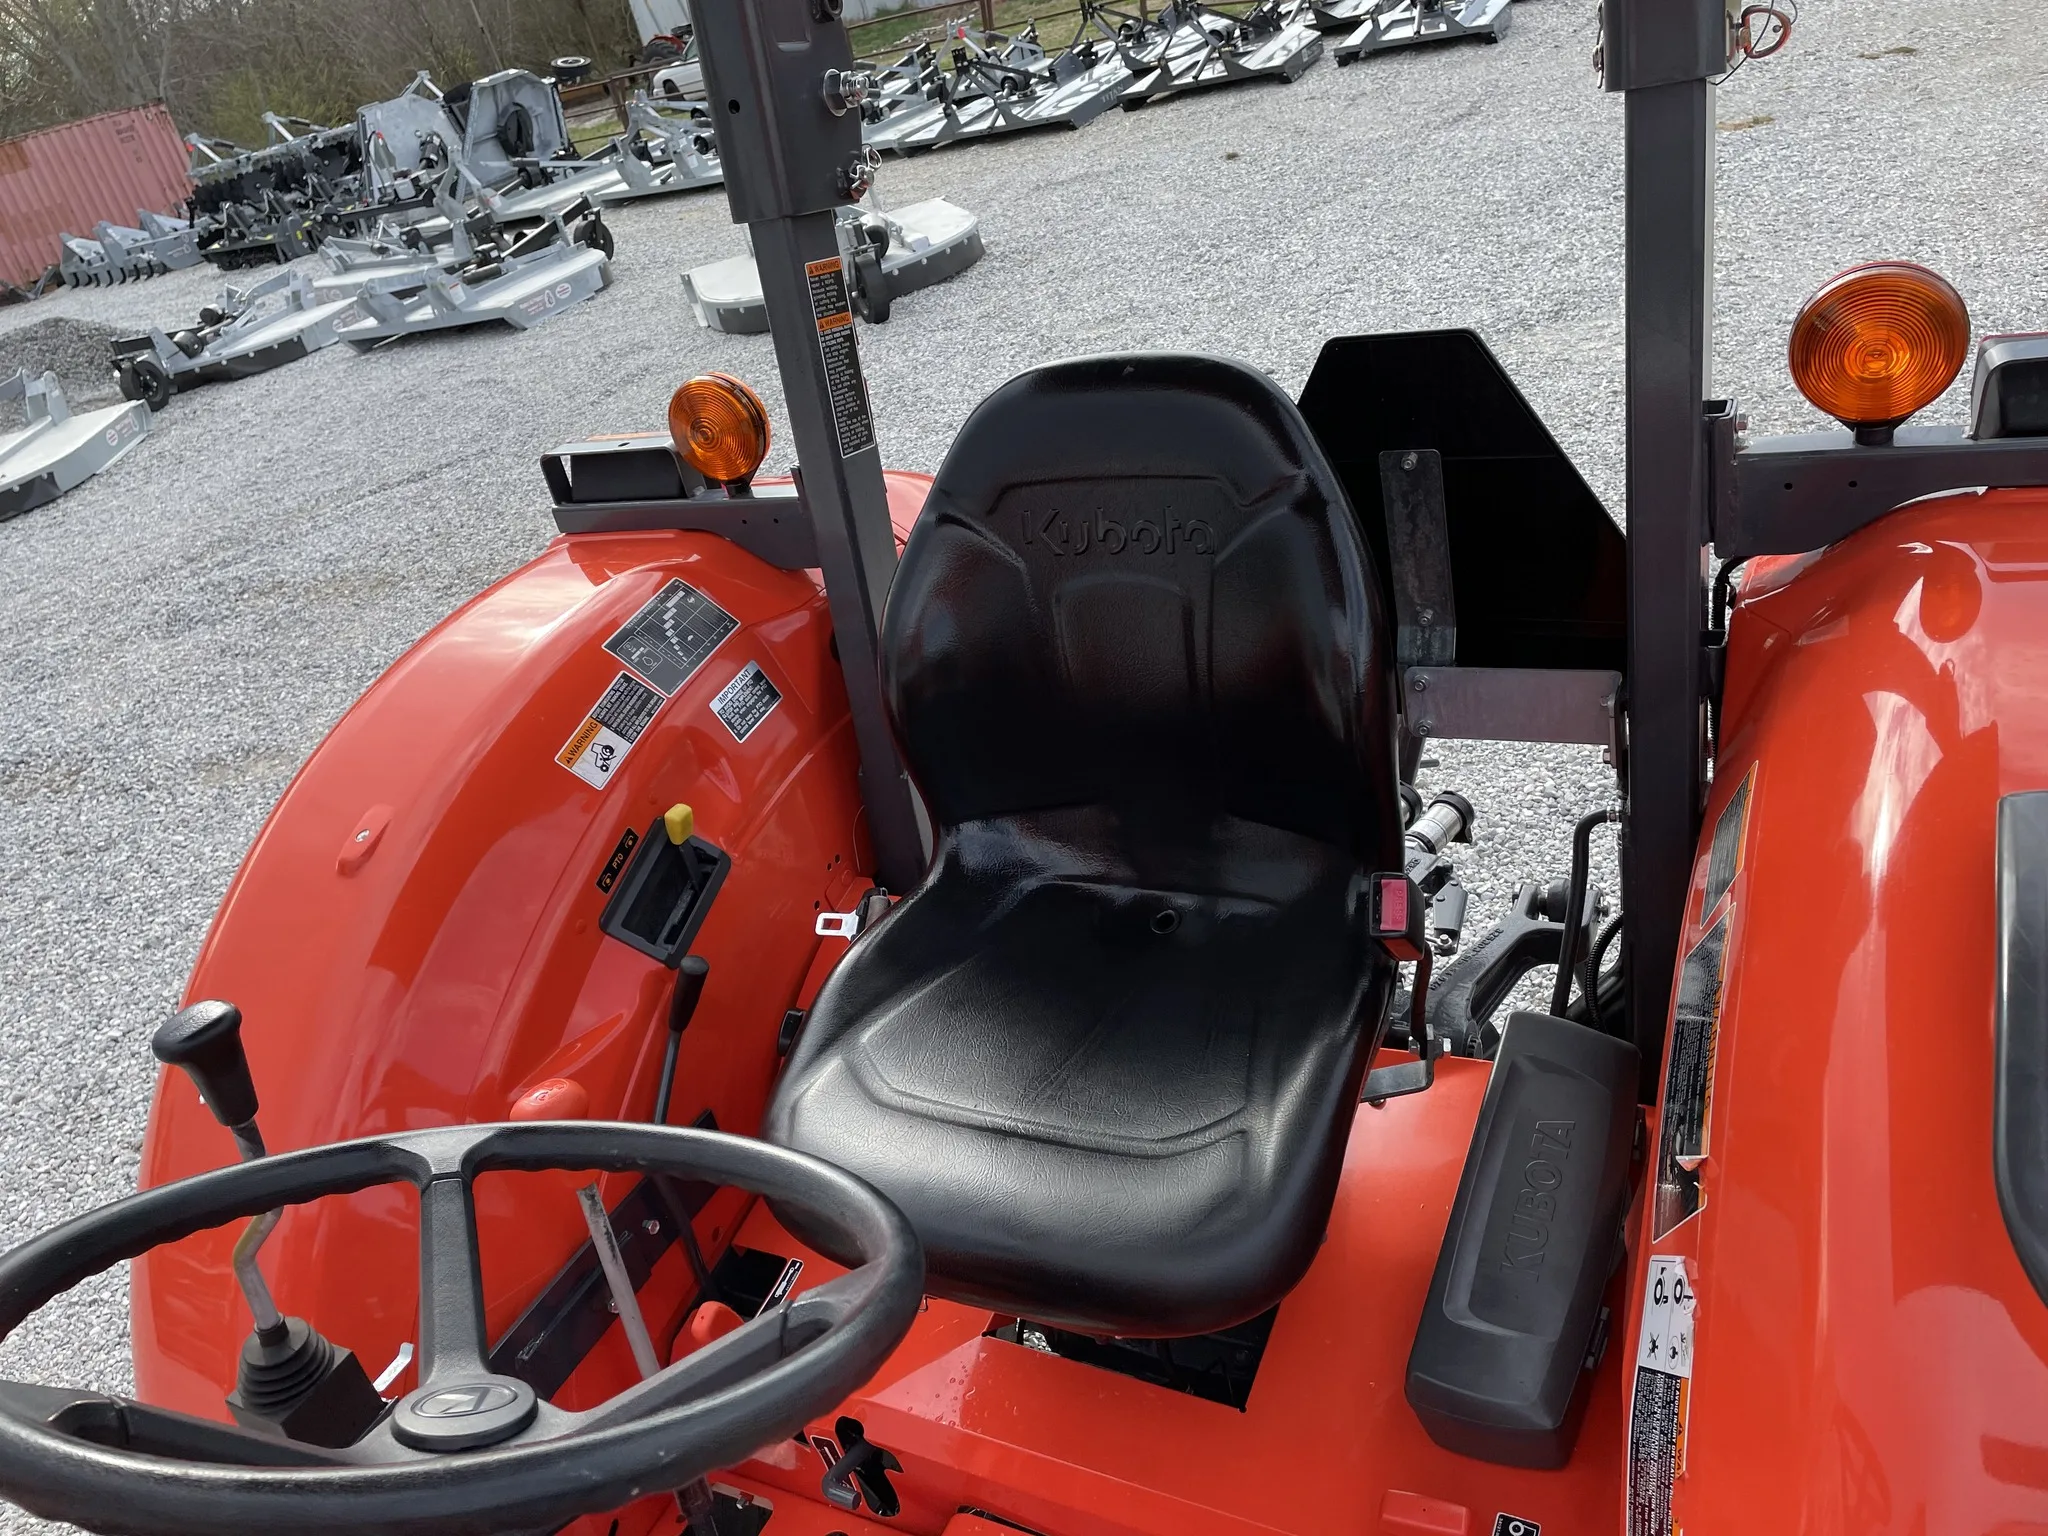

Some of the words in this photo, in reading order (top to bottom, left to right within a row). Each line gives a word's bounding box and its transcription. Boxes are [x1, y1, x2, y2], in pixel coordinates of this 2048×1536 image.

[814, 260, 839, 272] WARNING
[824, 314, 849, 326] WARNING
[1021, 505, 1215, 556] Kubota
[717, 669, 752, 705] IMPORTANT
[568, 721, 598, 757] WARNING
[612, 853, 624, 869] PTO
[1394, 888, 1403, 921] PRESS
[1500, 1120, 1576, 1283] KUBOTA
